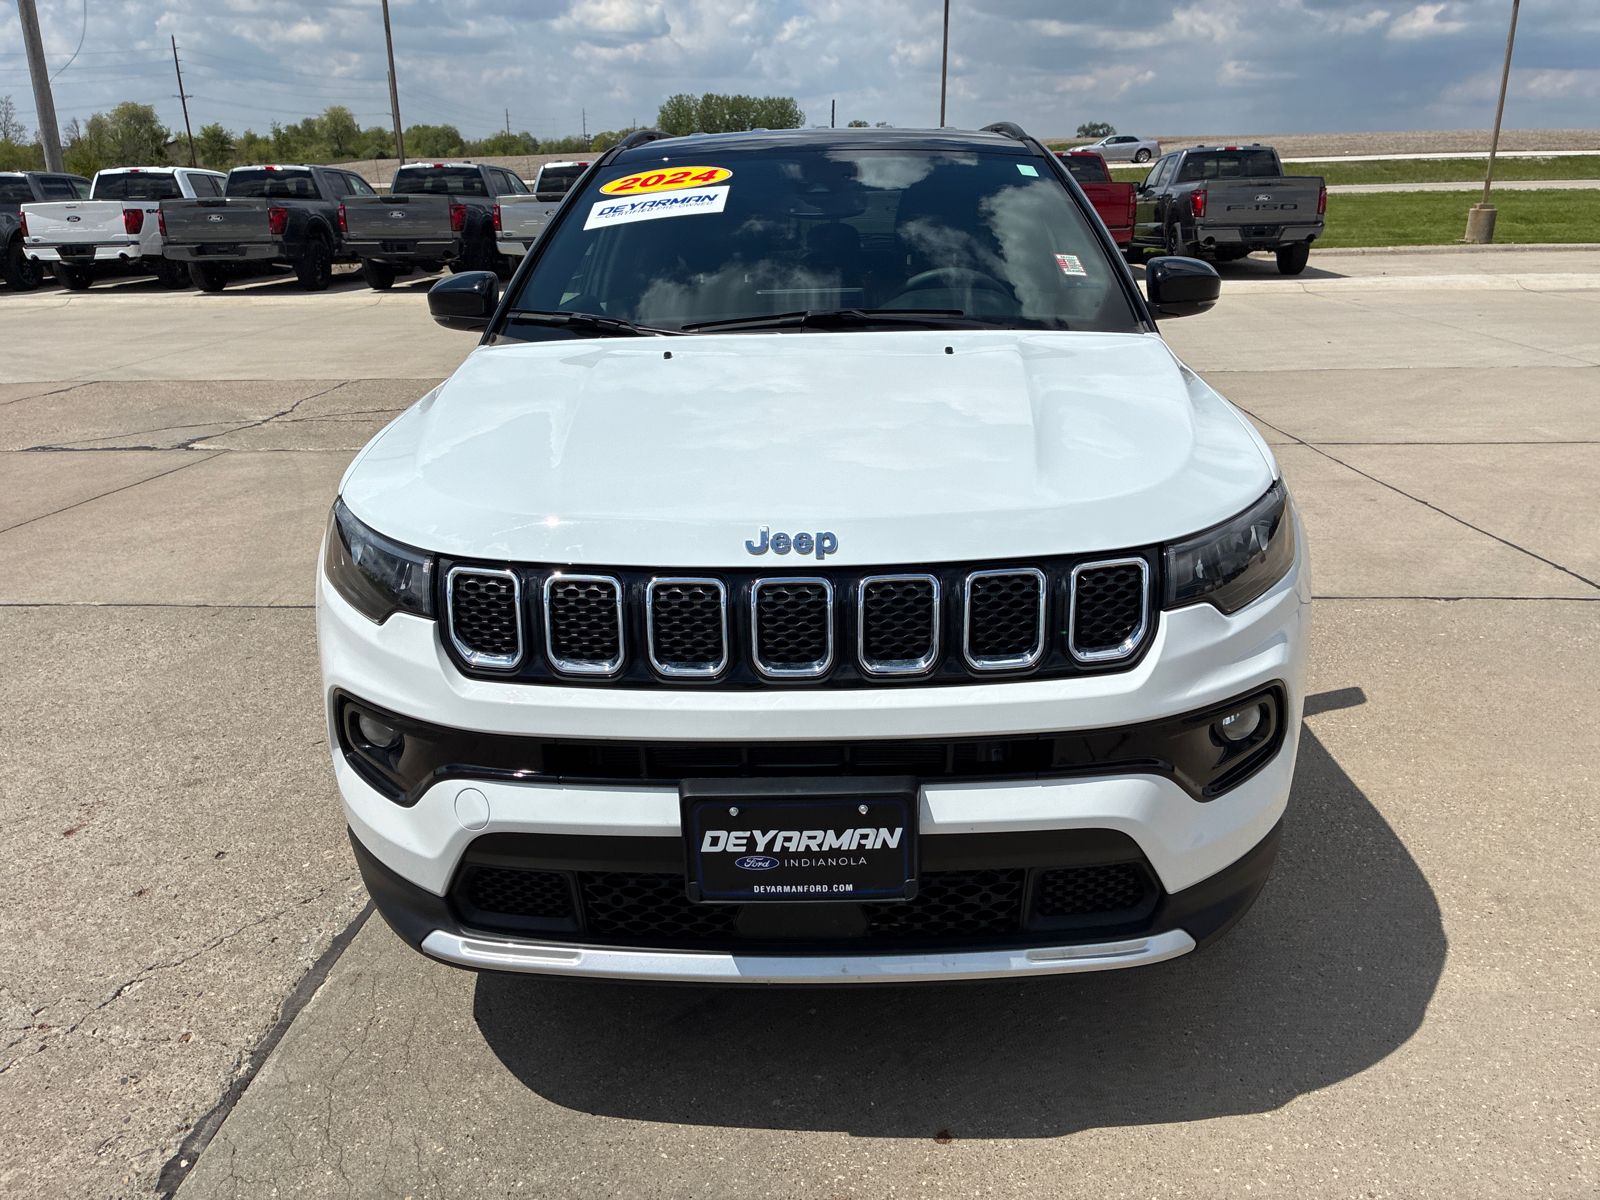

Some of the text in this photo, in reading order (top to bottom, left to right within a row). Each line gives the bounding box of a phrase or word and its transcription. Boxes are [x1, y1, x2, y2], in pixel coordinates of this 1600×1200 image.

[611, 169, 720, 193] 2024
[597, 193, 719, 217] DEYARMAN
[604, 201, 714, 219] CERTIFIED PRE-OWNED
[1226, 203, 1298, 212] F-150
[745, 525, 838, 560] Jeep
[700, 827, 903, 853] DEYARMAN
[784, 856, 867, 867] INDIANOLA
[753, 883, 853, 893] DEYARMANFORD.COM
